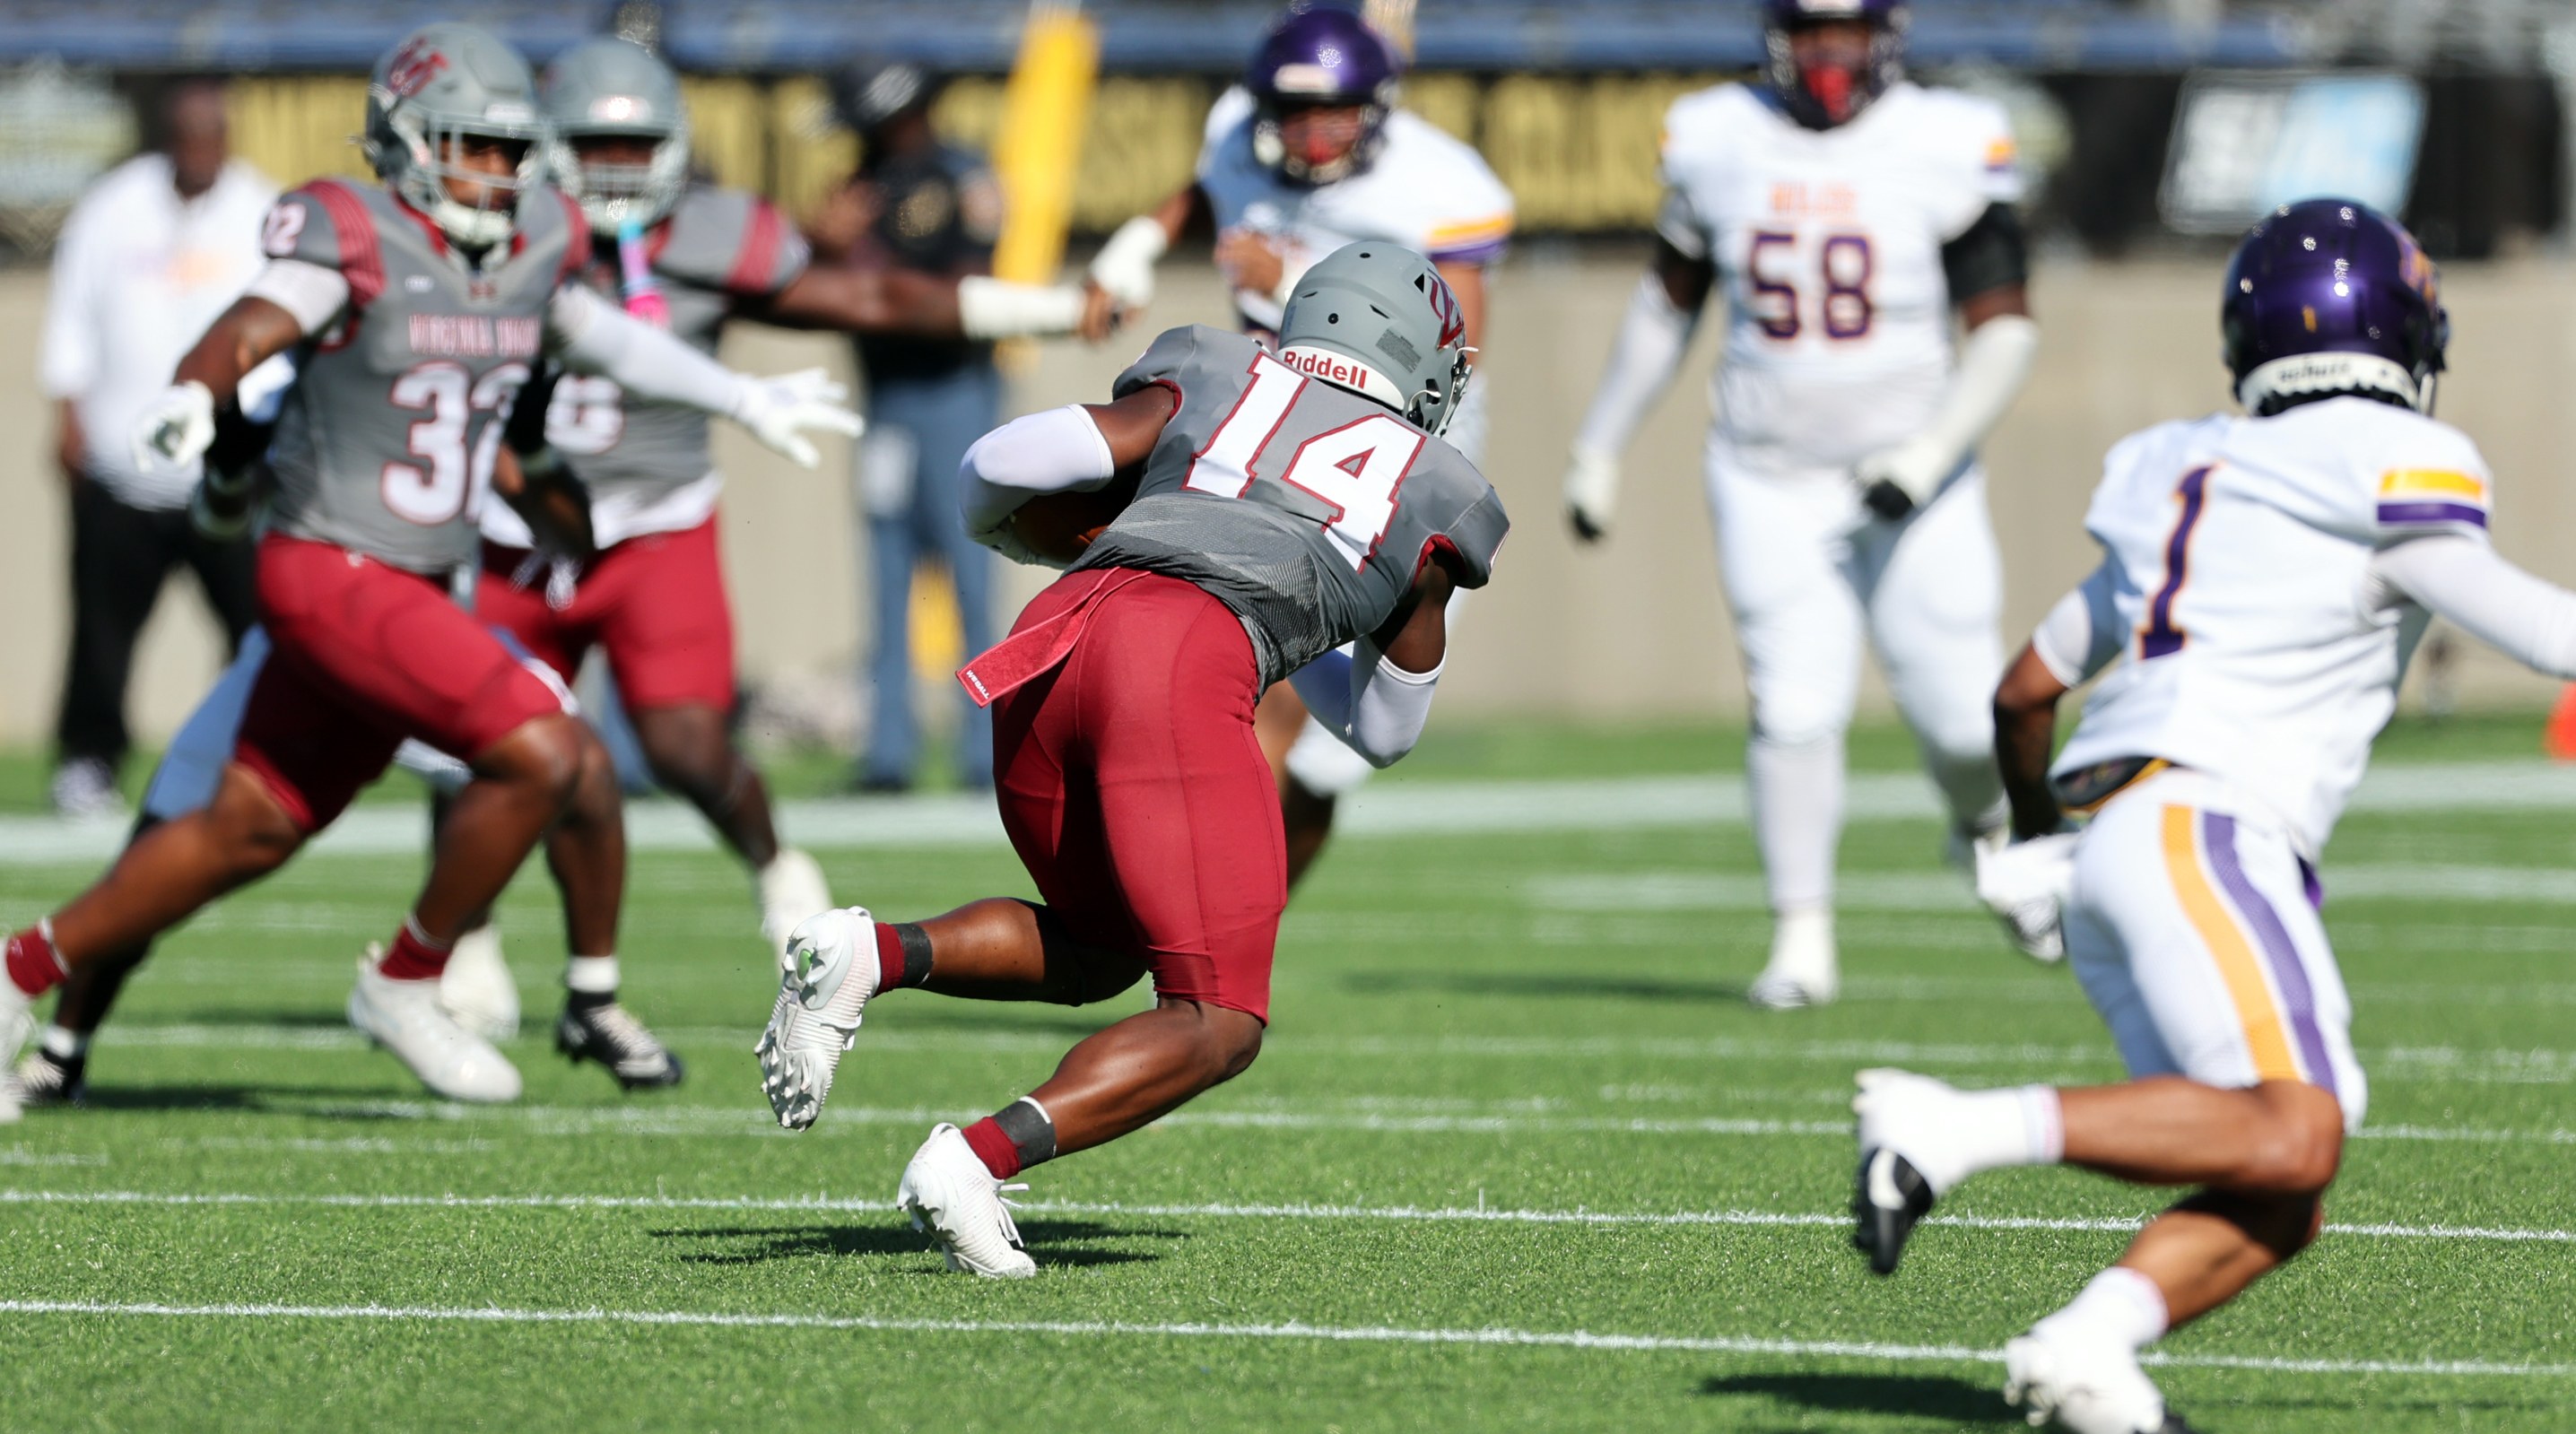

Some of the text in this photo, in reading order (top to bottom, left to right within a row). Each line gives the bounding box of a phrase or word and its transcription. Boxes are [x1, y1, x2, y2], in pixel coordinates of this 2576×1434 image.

[1749, 230, 1873, 340] 58
[1284, 351, 1368, 389] Riddell
[1179, 352, 1427, 575] 14
[2136, 465, 2218, 660] 1
